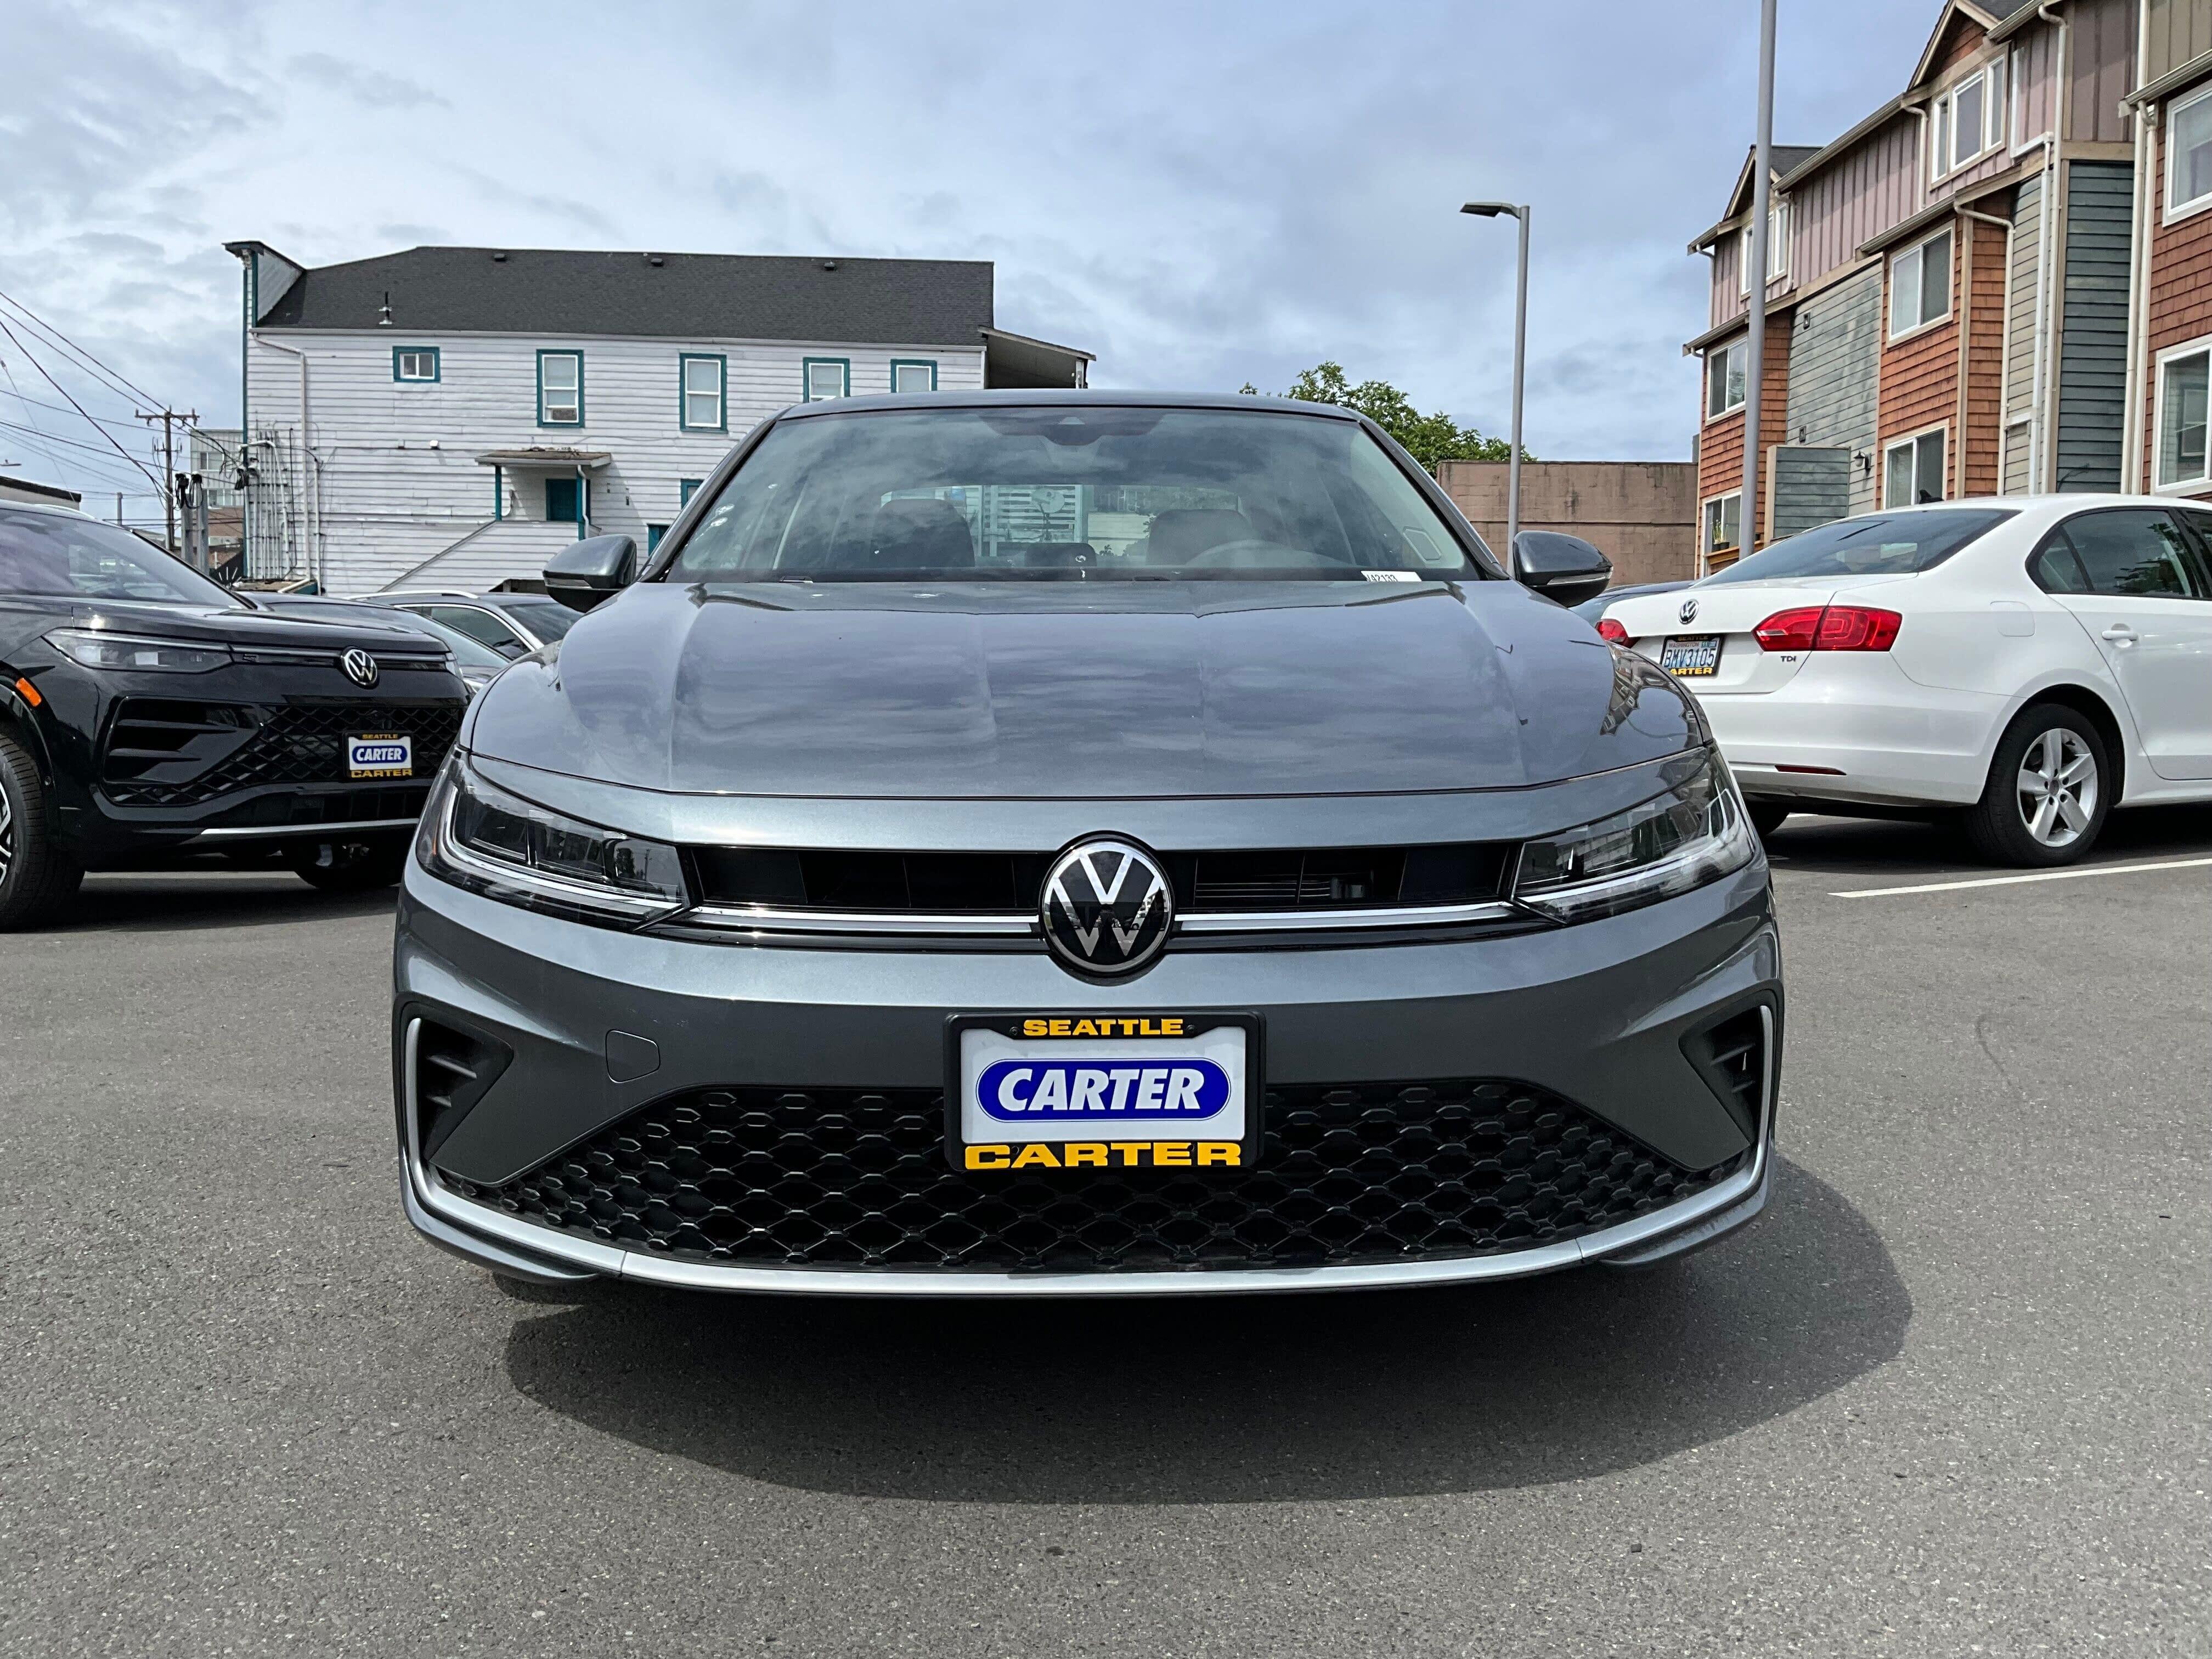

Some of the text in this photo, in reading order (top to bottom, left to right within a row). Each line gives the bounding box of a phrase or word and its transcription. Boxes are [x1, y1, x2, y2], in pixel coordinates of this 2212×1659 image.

[1664, 648, 1716, 667] BMV3105
[1669, 667, 1713, 676] ARTER
[356, 748, 403, 761] CARTER
[351, 769, 412, 778] CARTER
[1043, 841, 1171, 973] VW
[1023, 1019, 1184, 1036] SEATTLE
[998, 1068, 1204, 1111] CARTER
[965, 1142, 1242, 1170] CARTER
